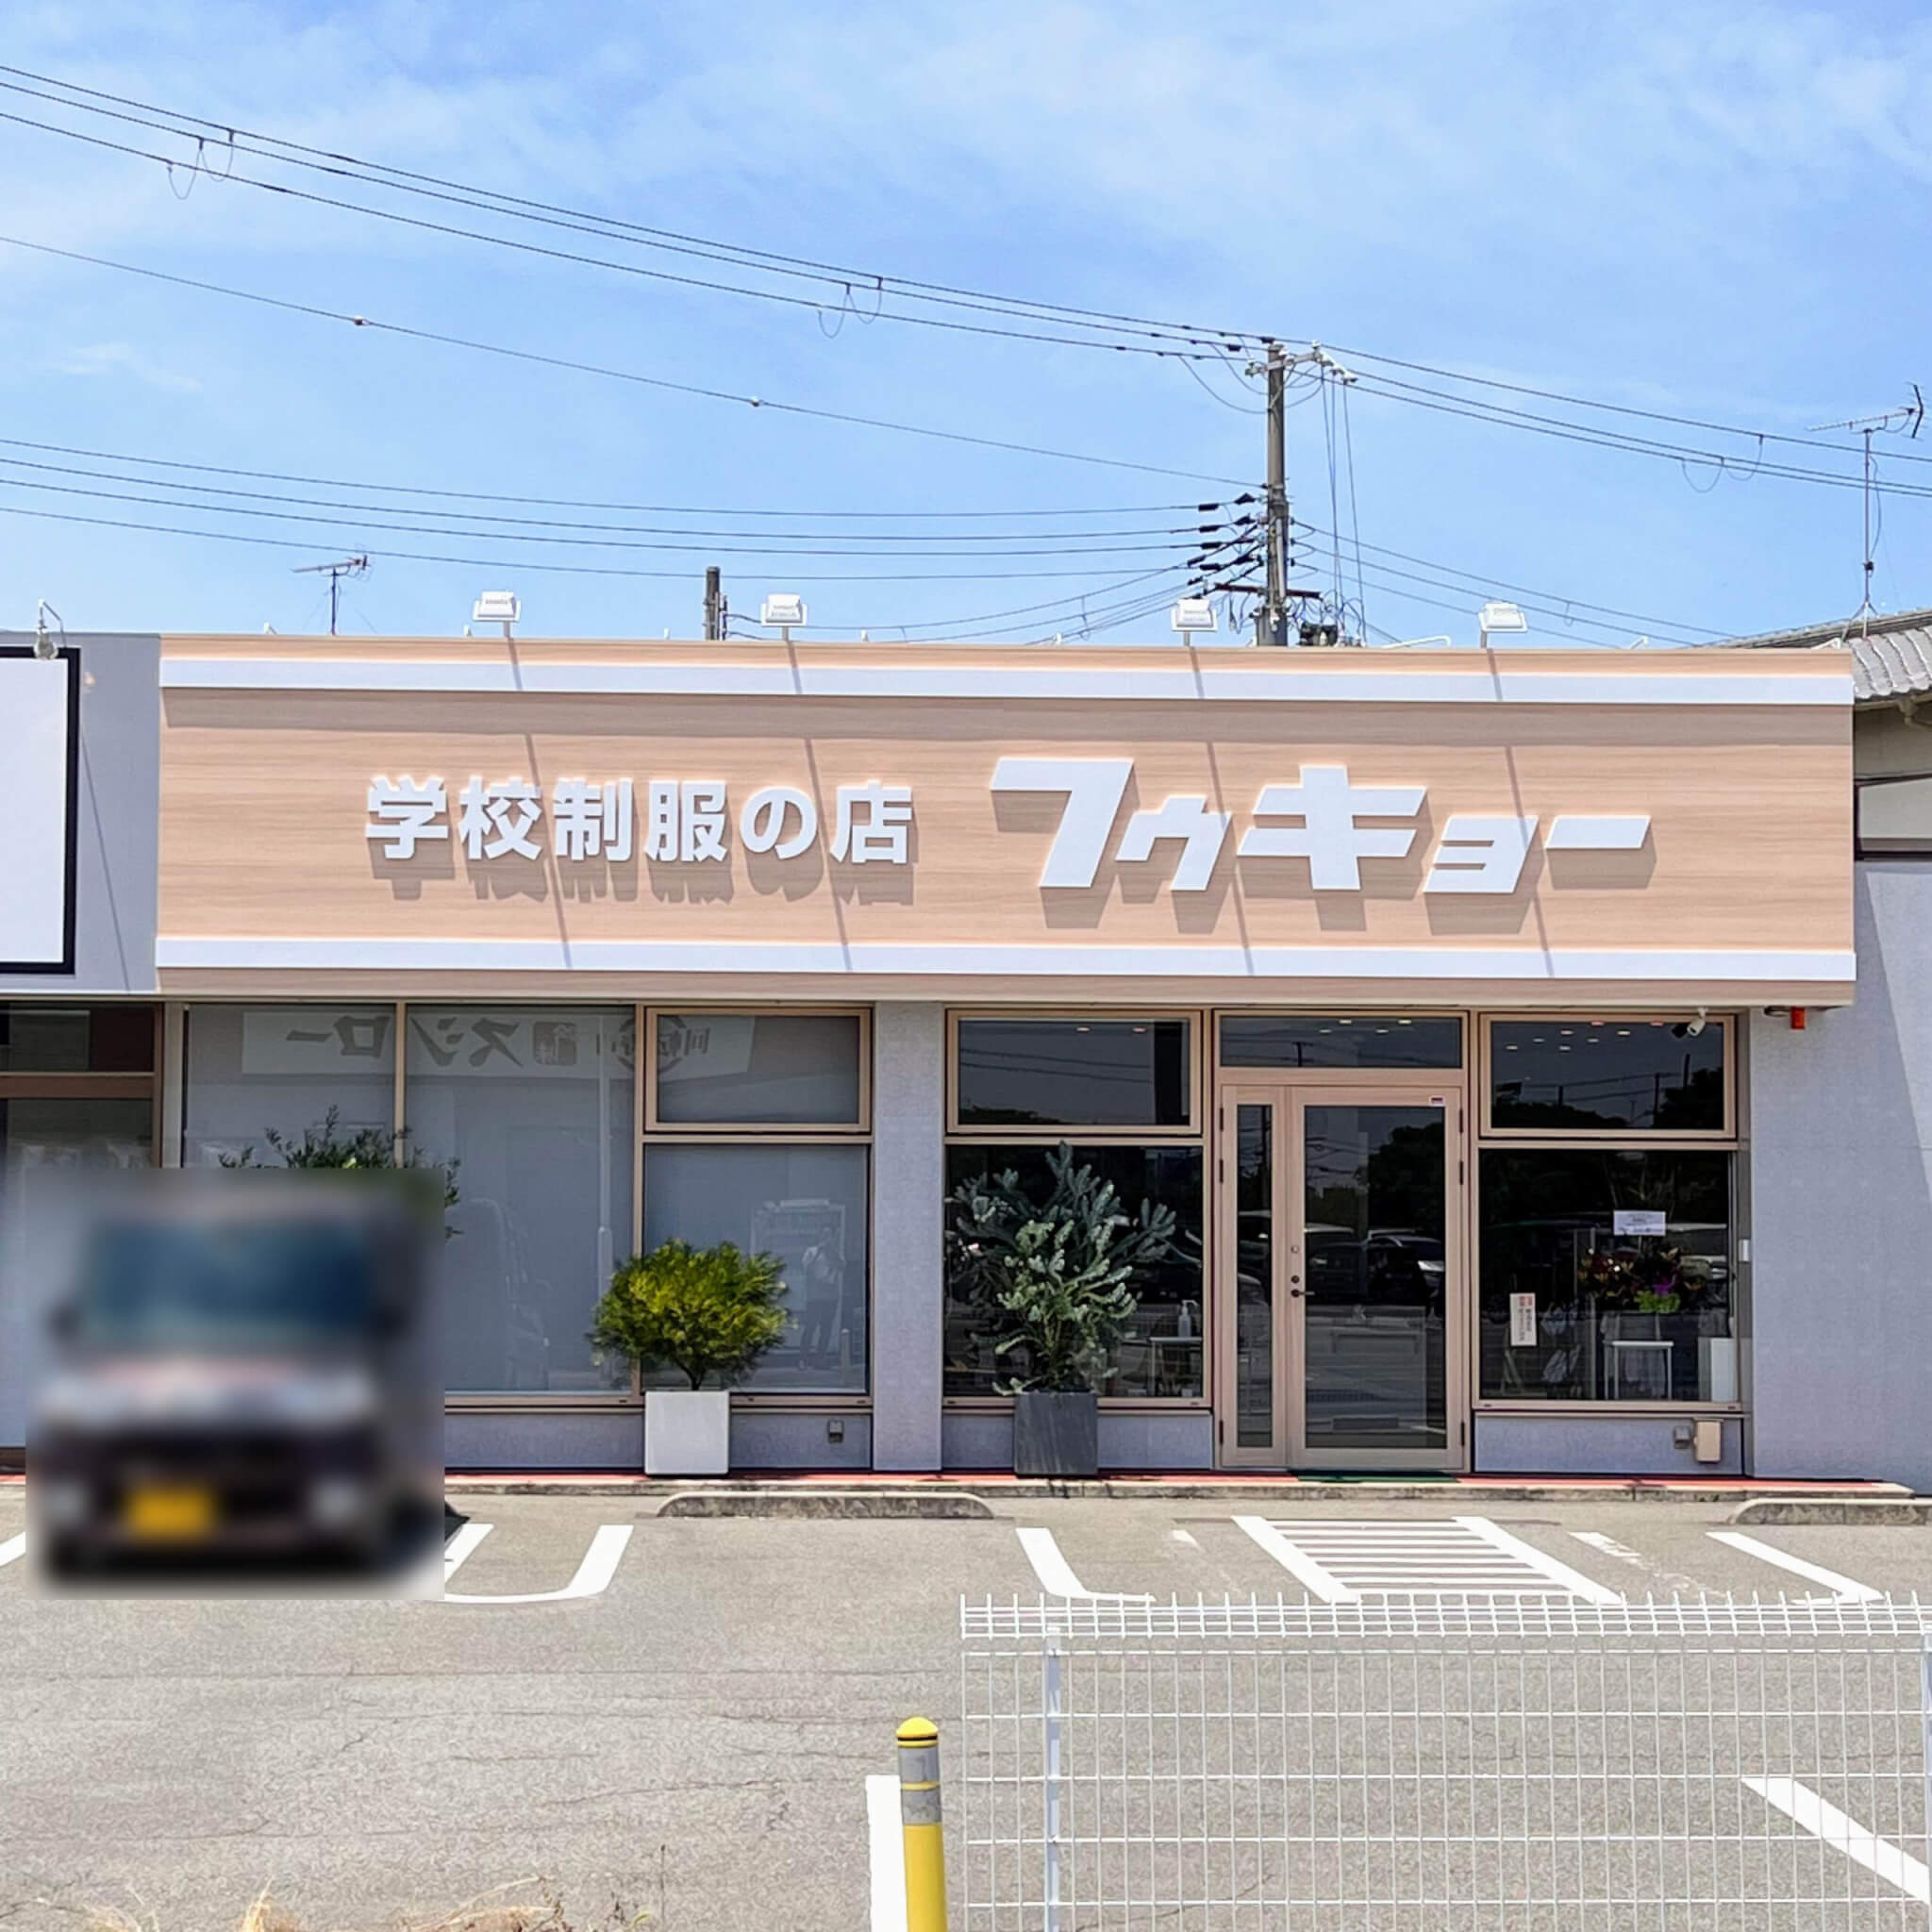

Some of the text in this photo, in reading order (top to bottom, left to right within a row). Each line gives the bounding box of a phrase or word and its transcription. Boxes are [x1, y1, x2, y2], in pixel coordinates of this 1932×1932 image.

[365, 775, 913, 864] 学校制服の店
